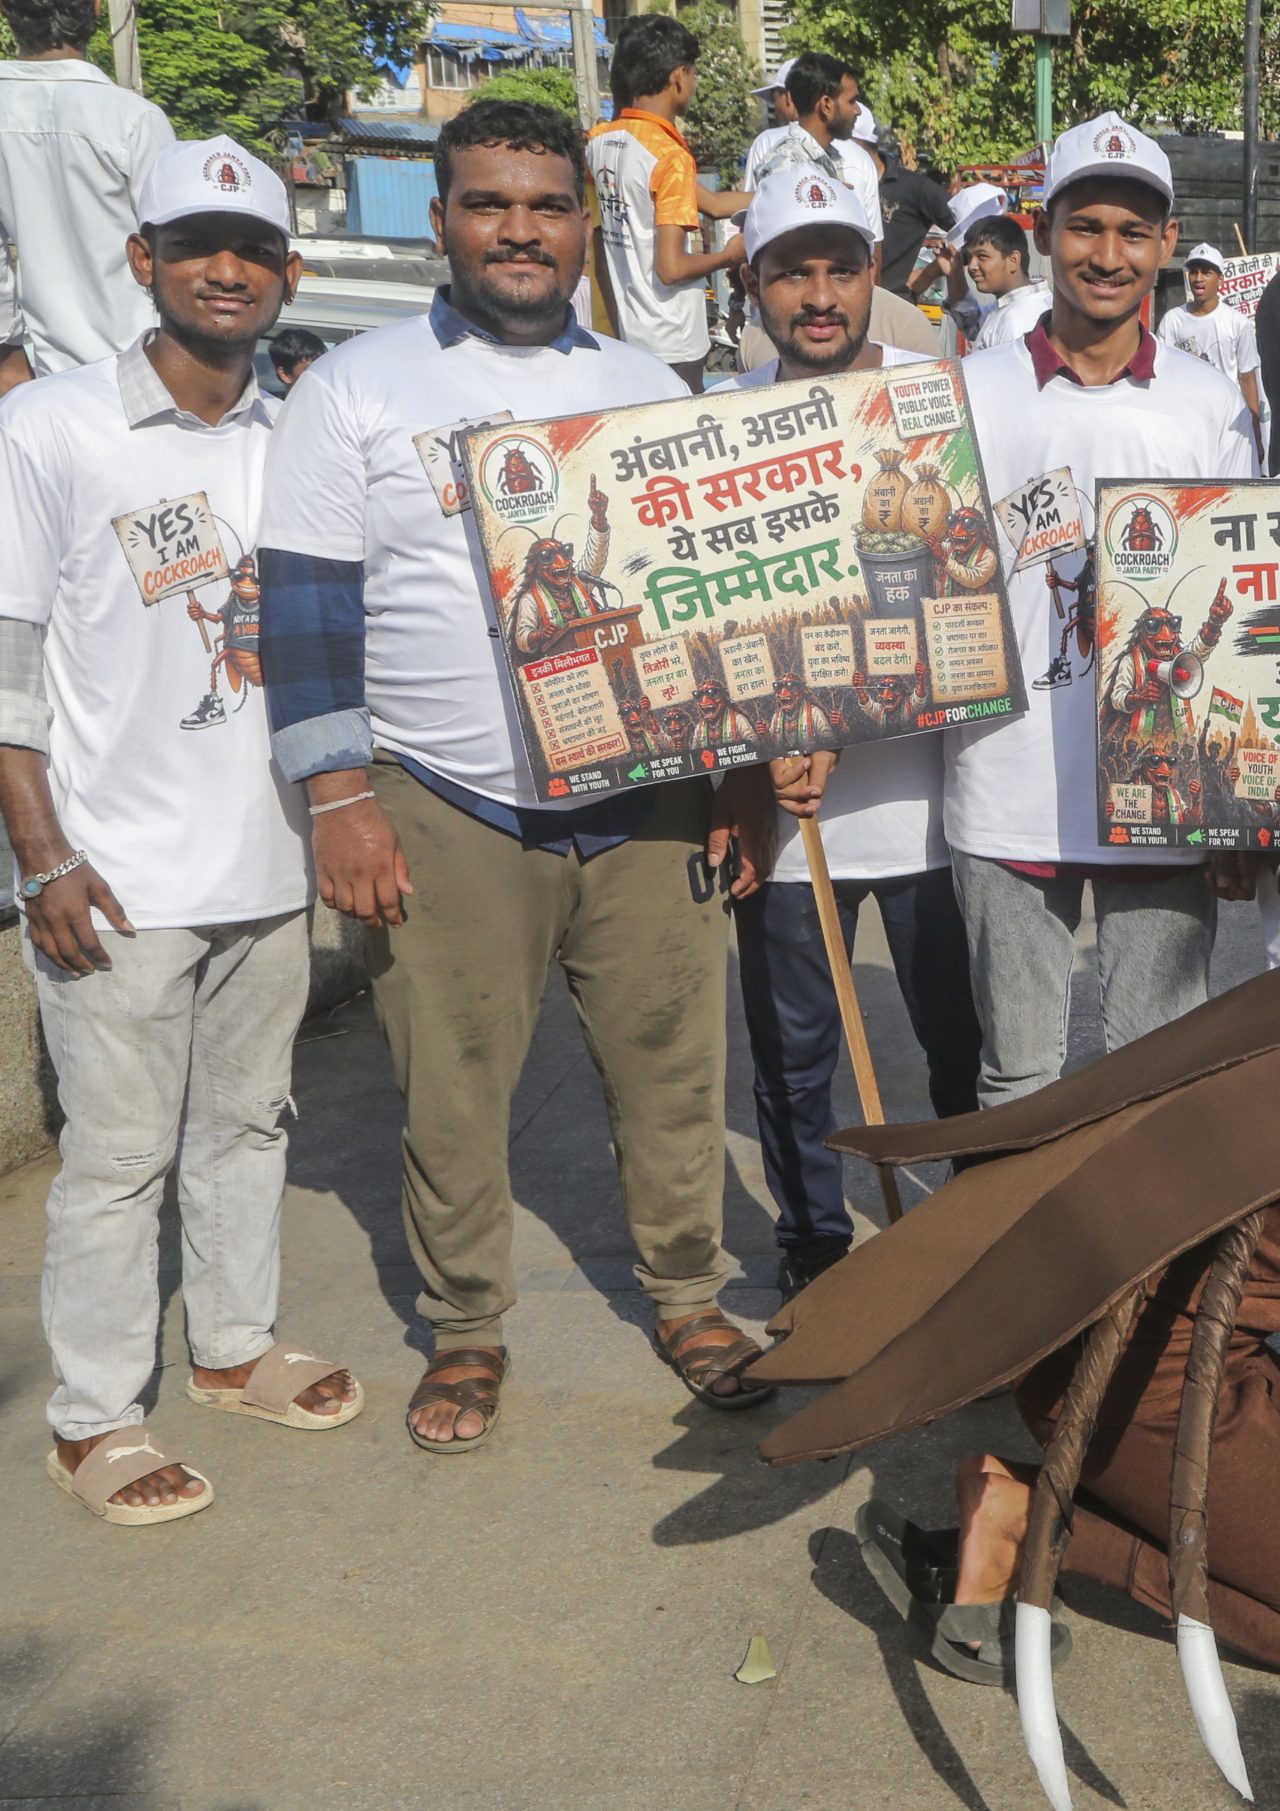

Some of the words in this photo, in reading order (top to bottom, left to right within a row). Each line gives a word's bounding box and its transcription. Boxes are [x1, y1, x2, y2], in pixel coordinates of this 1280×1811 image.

[220, 183, 240, 193] CJP
[892, 383, 922, 398] YOUTH
[921, 378, 950, 394] POWER
[898, 397, 928, 415] PUBLIC
[928, 394, 952, 410] VOICE
[901, 414, 923, 431] REAL
[923, 410, 957, 428] CHANGE
[610, 414, 740, 482] अंबानी,
[741, 385, 838, 448] अडानी
[631, 475, 694, 528] की
[697, 439, 862, 513] सरकार,
[872, 485, 896, 498] अंबानी
[495, 489, 555, 512] COCKROACH
[912, 494, 934, 507] अडानी
[1010, 479, 1056, 526] YES
[507, 506, 527, 519] JANTA
[527, 503, 548, 517] PARTY
[133, 503, 194, 549] YES
[667, 526, 699, 562] ये
[701, 515, 758, 555] सब
[761, 490, 841, 543] इसके
[1036, 508, 1061, 531] AM
[1210, 513, 1258, 552] ना
[157, 546, 170, 566] I
[176, 534, 200, 560] AM
[1114, 552, 1170, 566] COCKROACH
[143, 546, 222, 596] COCKROACH
[874, 569, 903, 585] जनता
[903, 568, 918, 582] का
[1121, 565, 1142, 575] JANTA
[1142, 565, 1162, 575] PARTY
[643, 537, 860, 631] जिम्मेदार.
[1232, 562, 1279, 602] ना
[884, 585, 910, 604] हक
[933, 603, 951, 615] CJP
[952, 603, 963, 612] का
[594, 623, 628, 648] CJP
[869, 627, 888, 636] जनता
[668, 640, 679, 651] की
[874, 641, 906, 651] व्यवस्था
[642, 657, 669, 675] तिजोरी
[731, 658, 743, 666] का
[873, 656, 892, 666] बदल
[893, 653, 912, 665] देगी!
[530, 662, 553, 677] इनकी
[732, 669, 753, 680] जनता
[753, 666, 765, 674] का
[644, 675, 665, 687] जनता
[916, 697, 1013, 729] #CJPFORCHANGE
[716, 747, 728, 757] WE
[728, 743, 746, 755] FIGHT
[1242, 751, 1267, 763] VOICE
[1267, 752, 1279, 763] OF
[650, 760, 662, 770] WE
[662, 756, 683, 768] SPEAK
[718, 755, 731, 767] FOR
[732, 751, 758, 764] CHANGE
[652, 768, 667, 779] FOR
[667, 766, 680, 776] YOU
[1247, 763, 1274, 775] YOUTH
[569, 774, 582, 784] WE
[583, 770, 602, 782] STAND
[1241, 774, 1266, 786] VOICE
[1266, 775, 1278, 787] OF
[571, 782, 590, 794] WITH
[590, 779, 610, 791] YOUTH
[1116, 787, 1130, 798] WE
[1130, 787, 1147, 798] ARE
[1247, 785, 1270, 798] INDIA
[1124, 798, 1138, 809] THE
[1115, 809, 1147, 820] CHANGE
[1130, 827, 1141, 837] WE
[1141, 827, 1162, 837] STAND
[1208, 828, 1220, 838] WE
[1220, 829, 1240, 838] SPEAK
[1130, 836, 1148, 845] WITH
[1148, 836, 1168, 845] YOUTH
[1208, 837, 1222, 847] FOR
[1222, 838, 1236, 847] YOU
